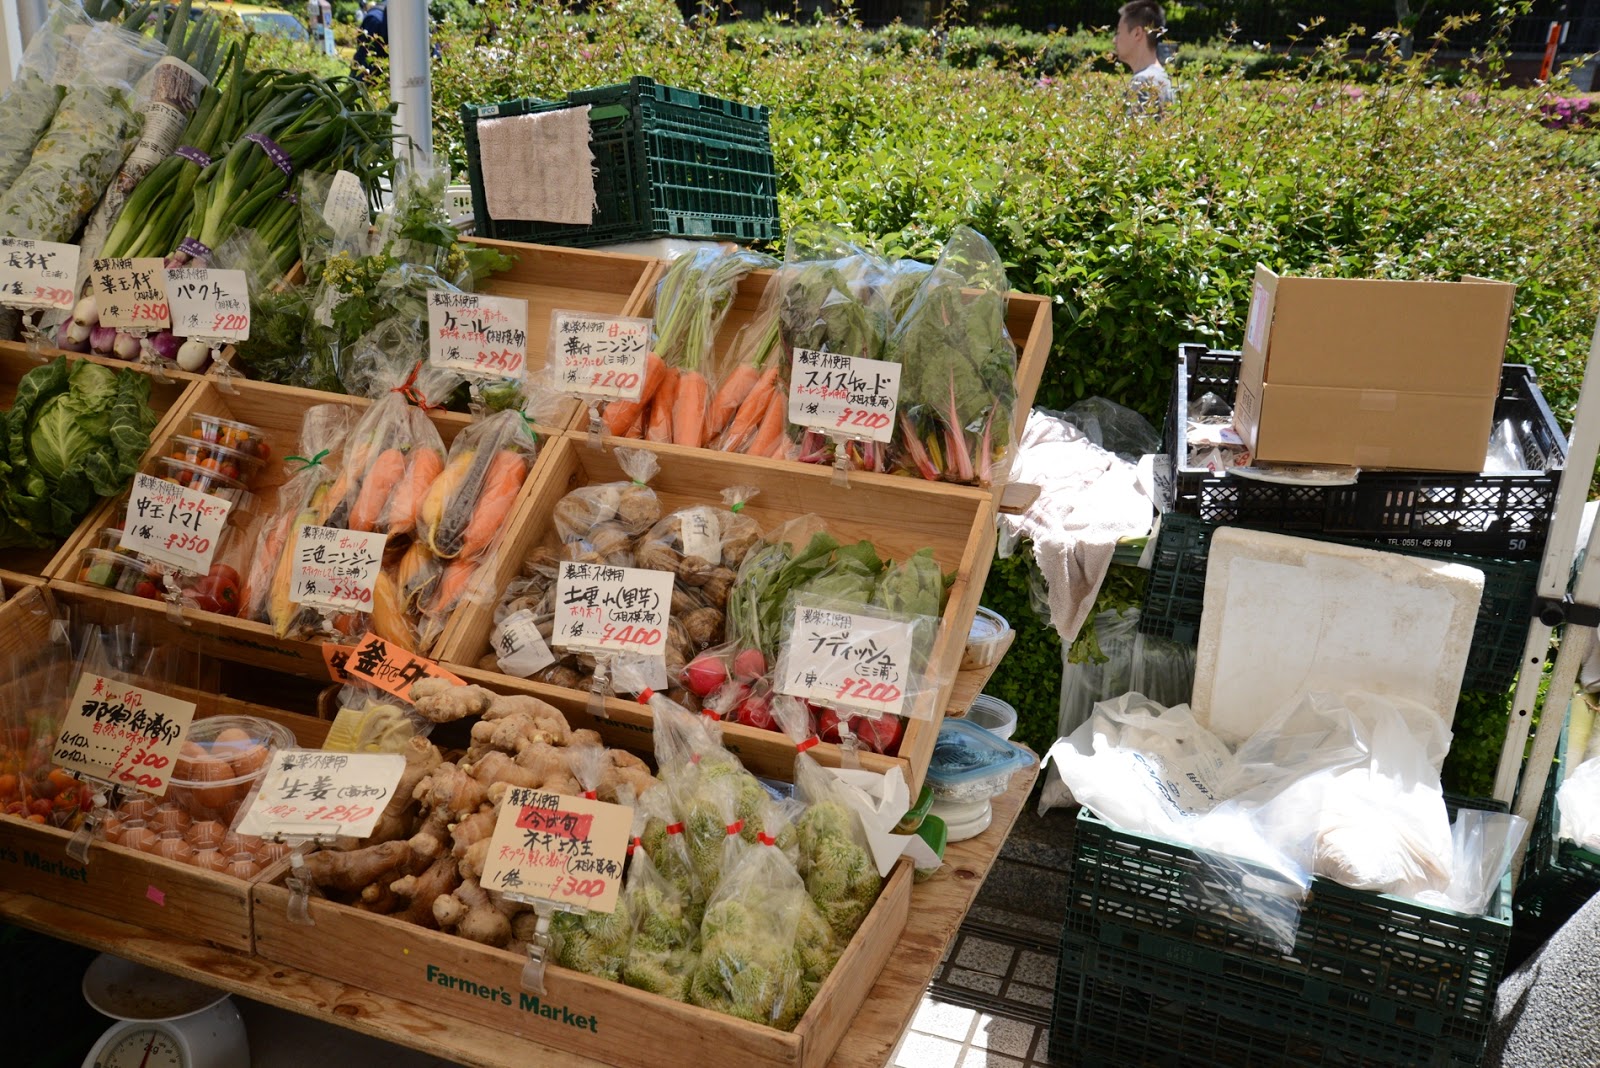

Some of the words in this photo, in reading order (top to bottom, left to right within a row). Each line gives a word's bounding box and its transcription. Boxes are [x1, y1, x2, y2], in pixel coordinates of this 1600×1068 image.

[4, 251, 56, 270] 長ネギ
[100, 269, 153, 294] 葉玉ネギ
[177, 282, 229, 300] パクチー
[32, 286, 74, 305] ¥300
[132, 303, 168, 322] ¥350
[212, 313, 248, 331] ¥200
[444, 311, 492, 333] ケール
[474, 348, 522, 372] ¥250
[590, 370, 639, 389] ¥200
[805, 370, 891, 395] スイスチャード
[835, 408, 890, 429] ¥200
[137, 496, 202, 531] 中玉トマト
[164, 533, 210, 554] ¥350
[302, 544, 378, 565] 三色ニンジン
[1508, 539, 1527, 550] 50
[328, 585, 371, 603] ¥350
[599, 623, 662, 646] ¥400
[808, 632, 896, 667] ラディッシュ
[836, 677, 901, 702] ¥200
[118, 745, 169, 769] ¥300
[107, 762, 162, 788] ¥600
[278, 775, 336, 801] 生姜
[305, 804, 374, 823] ¥250
[23, 851, 88, 884] Market
[549, 876, 605, 898] ¥300
[427, 963, 513, 1006] Farmer's
[519, 992, 598, 1034] Market
